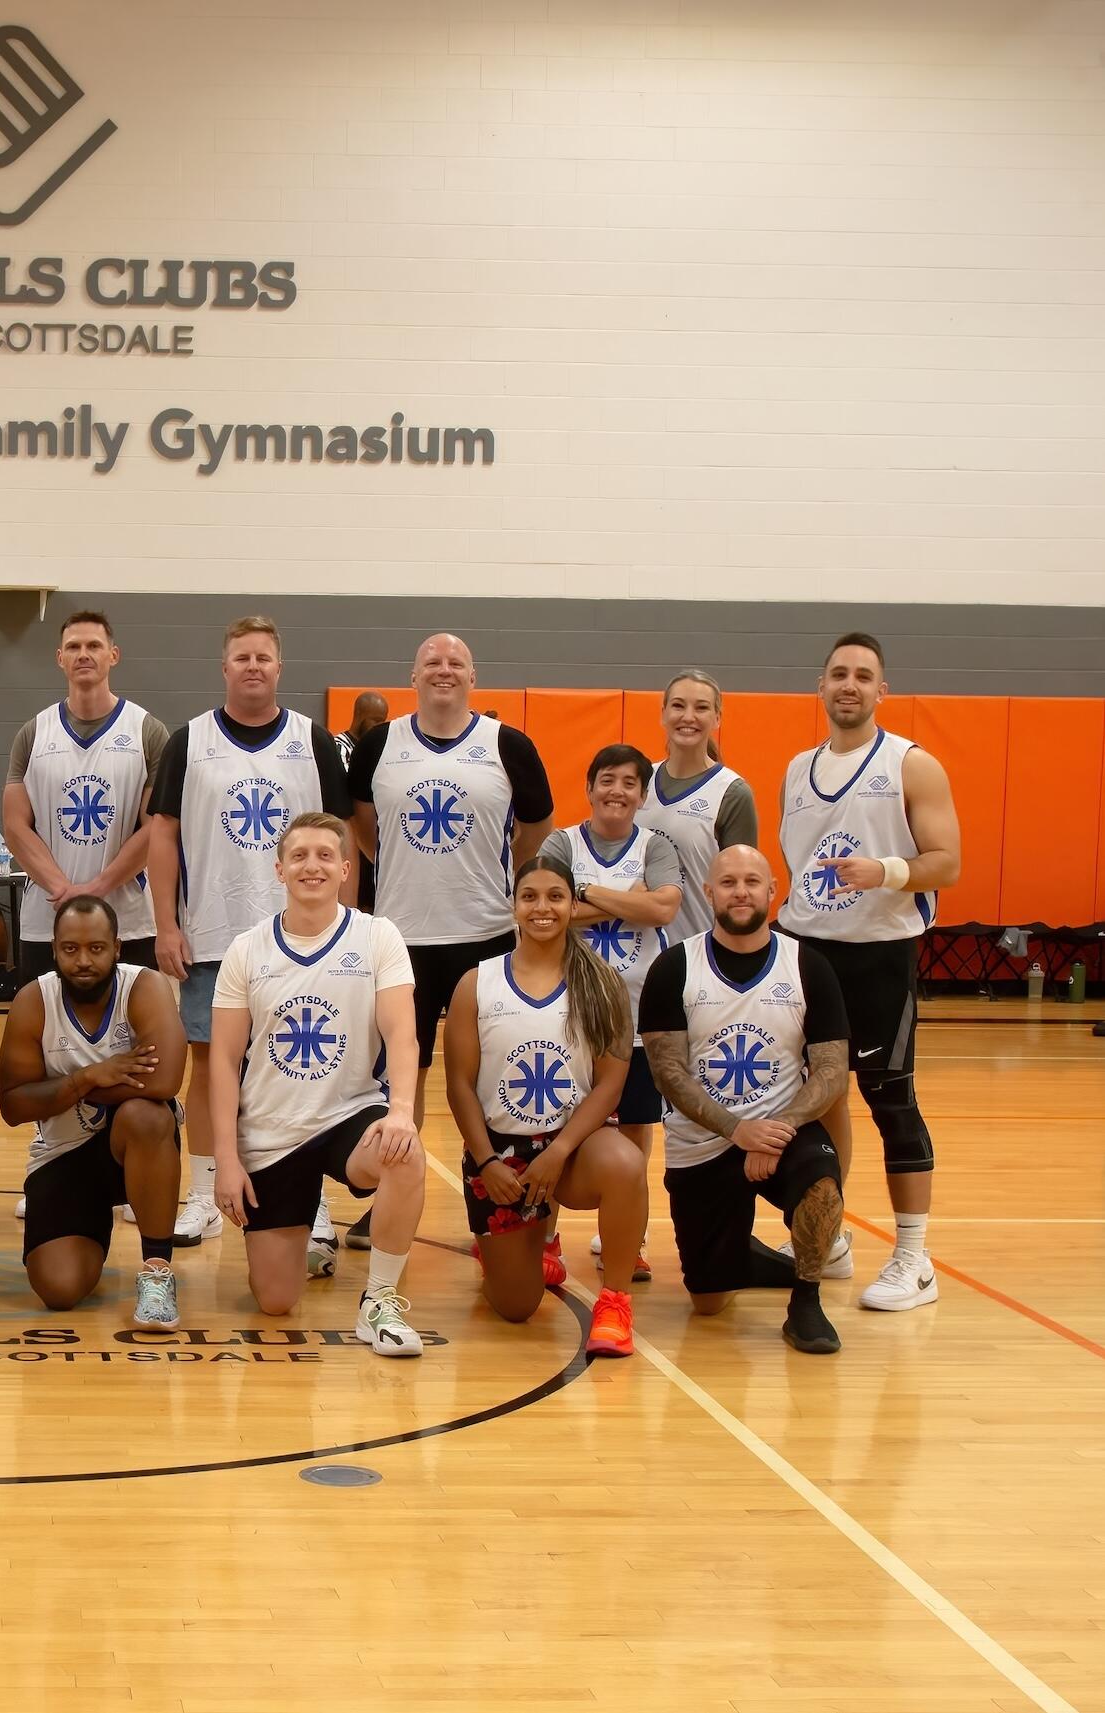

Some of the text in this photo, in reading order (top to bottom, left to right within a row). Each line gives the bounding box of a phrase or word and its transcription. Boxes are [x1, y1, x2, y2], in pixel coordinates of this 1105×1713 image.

[86, 258, 297, 310] CLUBS
[150, 408, 494, 475] Gymnasium
[227, 778, 283, 796] SCOTTSDALE
[406, 779, 467, 799] SCOTTSDALE
[221, 811, 259, 851] COMMUNITY
[400, 813, 474, 854] COMMUNITY ALL-STARS
[803, 873, 863, 911] COMMUNITY ALL-S
[274, 995, 340, 1018] SCOTTSDALE
[507, 1040, 571, 1064] SCOTTSDALE
[708, 1023, 775, 1045] SCOTTSDALE
[268, 1034, 346, 1080] COMMUNITY ALL-STARS
[498, 1079, 542, 1125] COMMUNITY
[699, 1059, 779, 1105] COMMUNITY ALL-STARS
